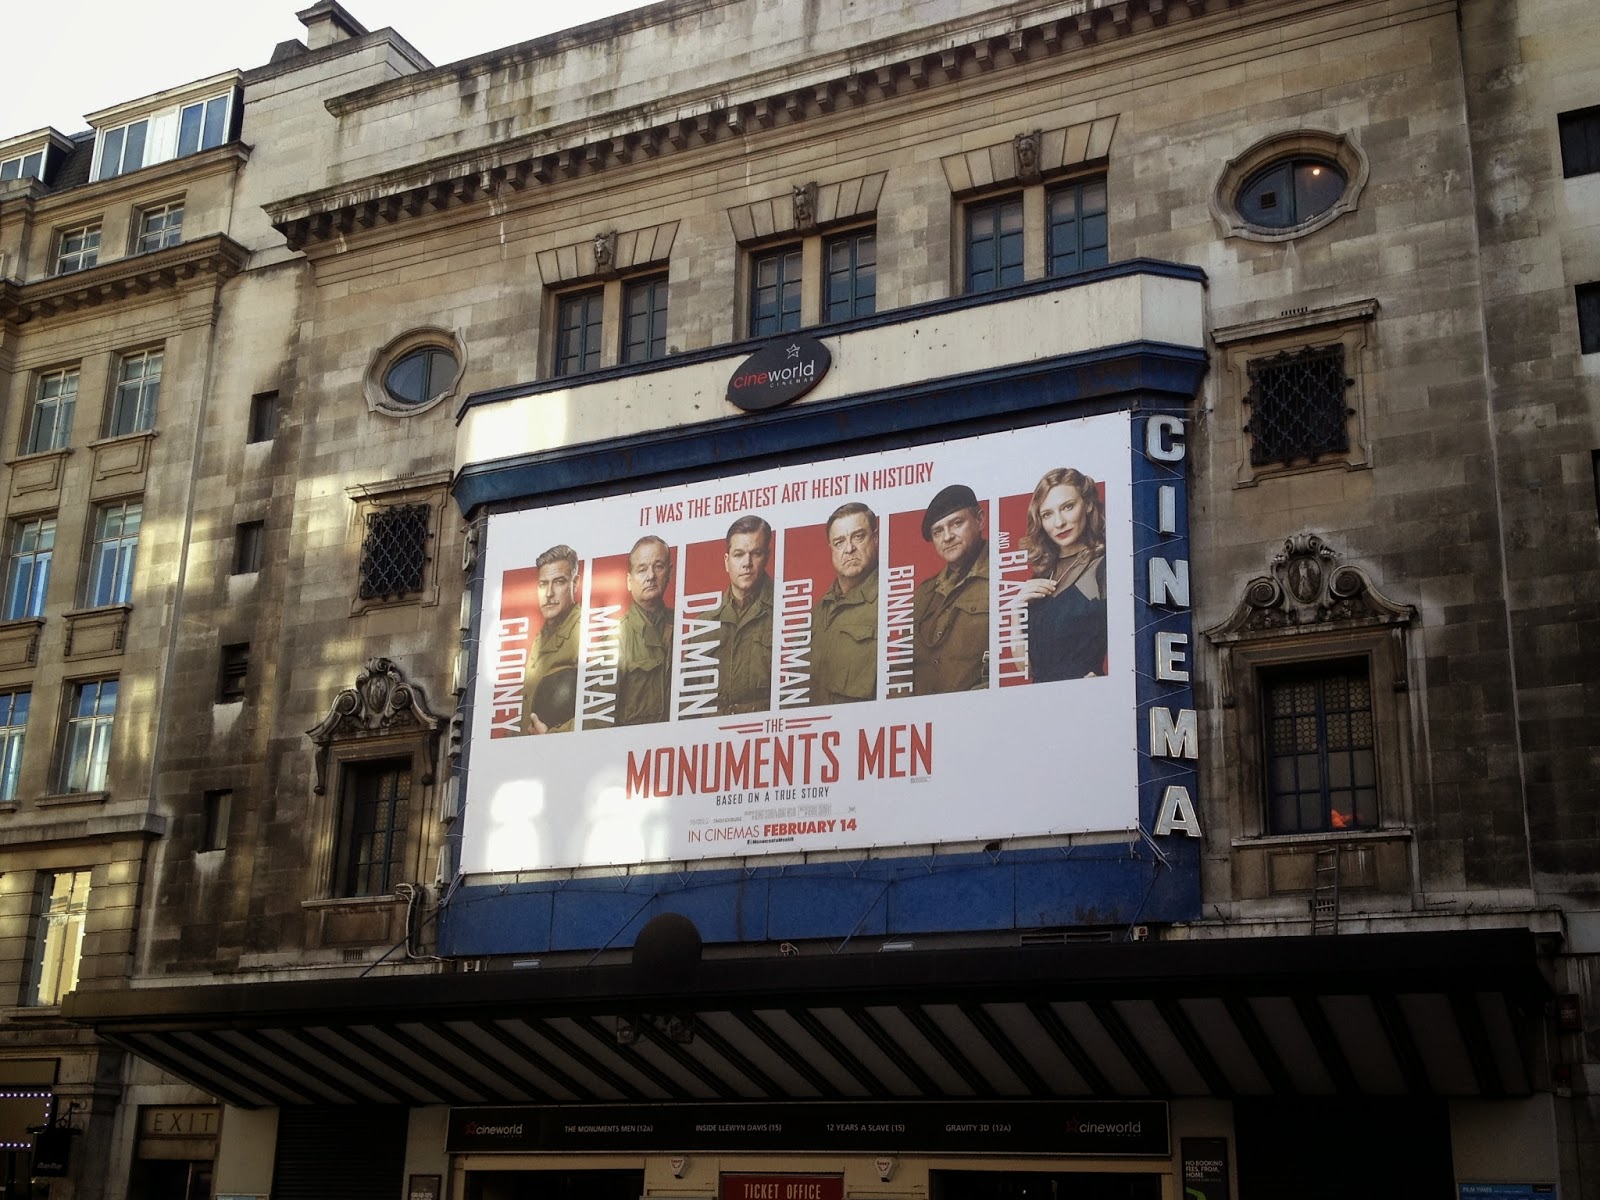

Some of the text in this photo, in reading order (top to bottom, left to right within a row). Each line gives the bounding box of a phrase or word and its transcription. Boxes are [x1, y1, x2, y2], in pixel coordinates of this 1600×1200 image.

[733, 360, 814, 388] cineworld
[770, 377, 814, 388] CINEMAS
[640, 462, 934, 526] IT WAS THE GREATEST ART HEIST IN HISTORY
[999, 531, 1029, 680] AND BLANCHETT
[886, 564, 915, 695] BONNEVILLE
[1145, 414, 1202, 837] CINEMA
[779, 578, 812, 706] GOODMAN
[582, 604, 621, 723] MURRAY
[678, 590, 722, 717] DAMON
[491, 616, 529, 732] CLOONEY
[765, 718, 784, 734] THE
[626, 722, 932, 799] MONUMENTS MEN
[716, 786, 830, 806] BASED ON A TRUE STORY
[688, 818, 857, 843] IN CINEMAS FEBRUARY 14
[153, 1112, 214, 1132] EXIT
[476, 1123, 523, 1135] cineworld
[578, 1125, 620, 1133] MONUMENTS
[696, 1123, 782, 1132] INSIDE LLEWYN DAVIS (15)
[826, 1123, 835, 1131] 12
[861, 1124, 867, 1132] A
[868, 1124, 890, 1132] SLAVE
[891, 1124, 905, 1132] (15)
[946, 1124, 977, 1132] GRAVITY
[979, 1124, 989, 1132] 3D
[1079, 1121, 1141, 1133] cineworld
[744, 1183, 822, 1200] TICKET OFFICE
